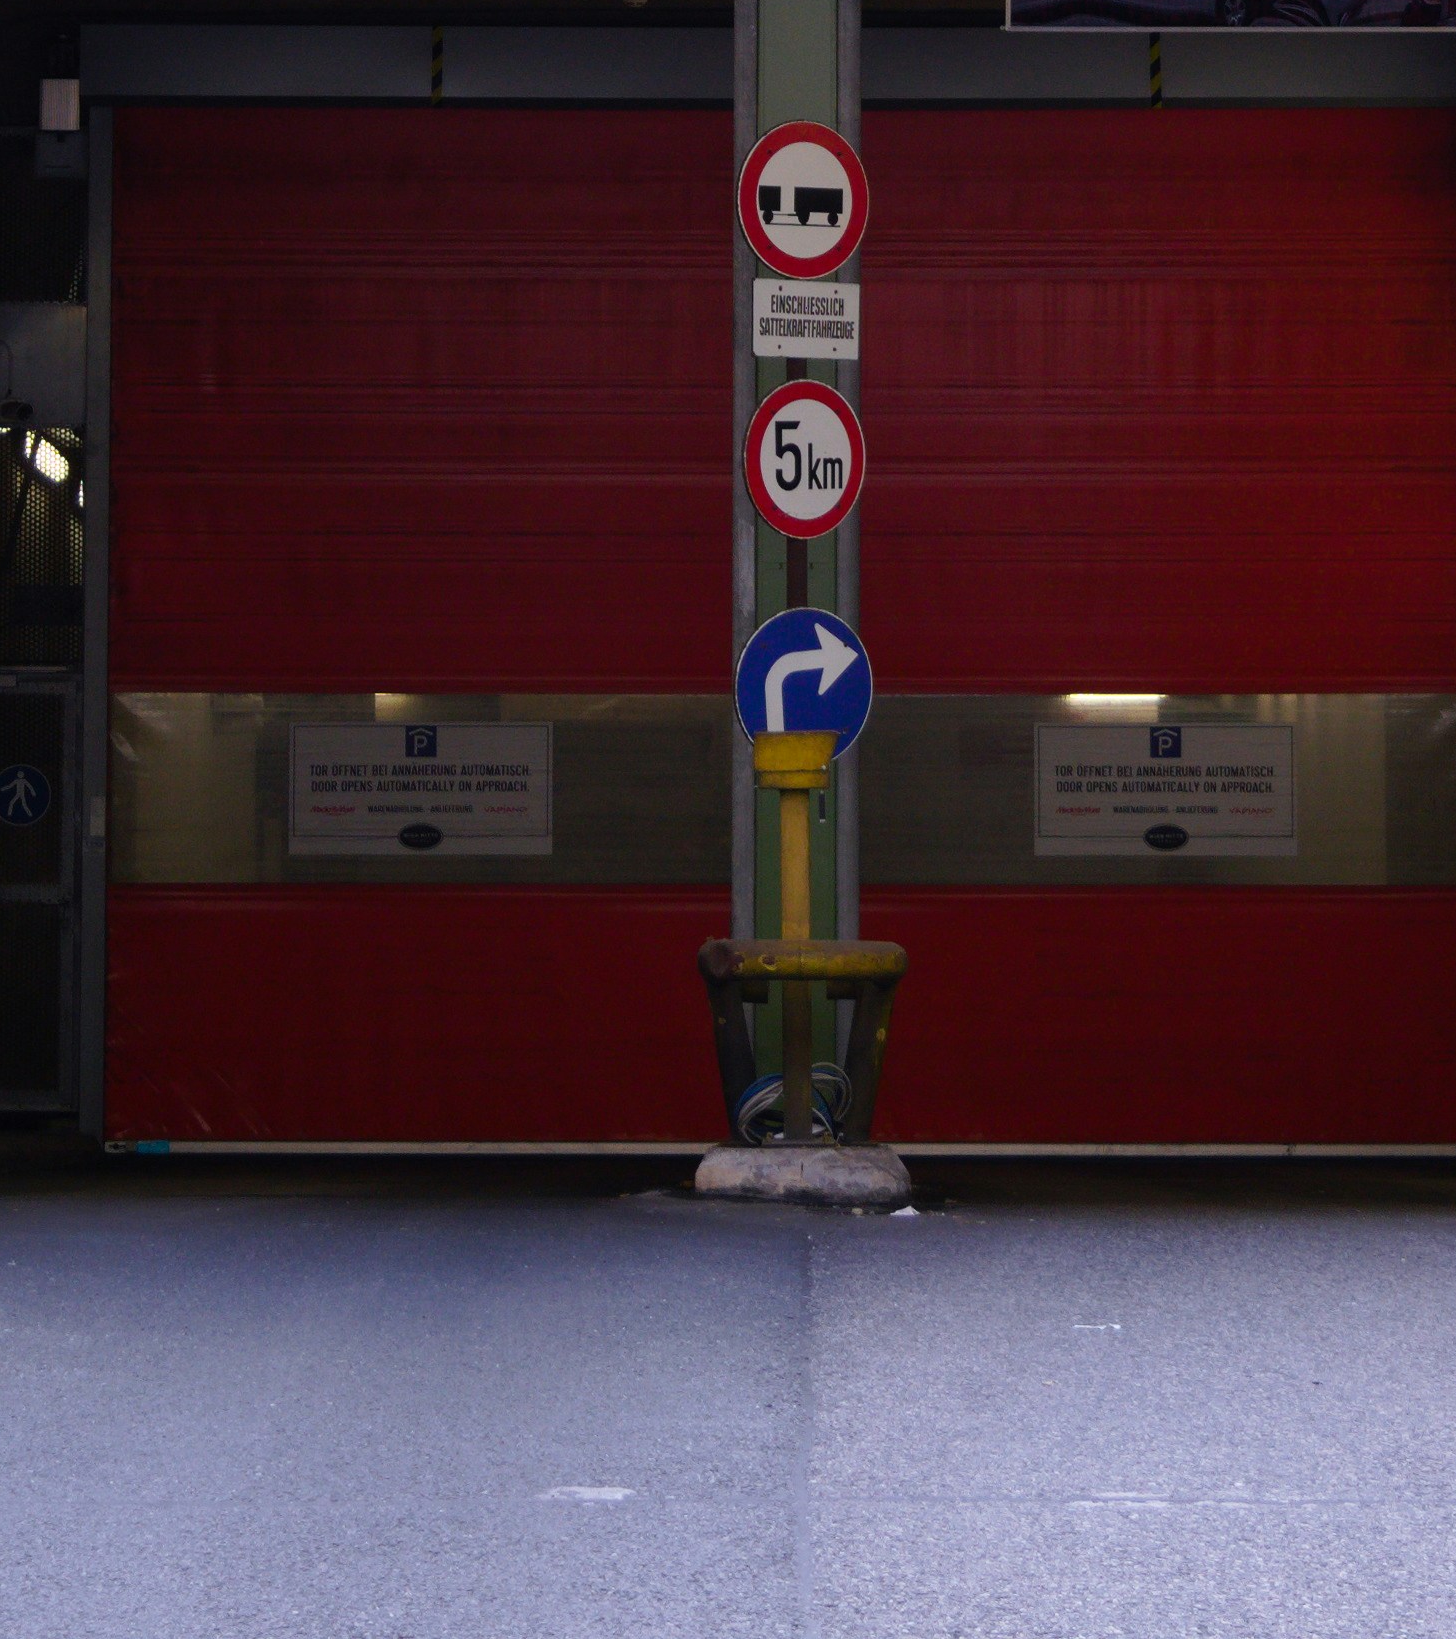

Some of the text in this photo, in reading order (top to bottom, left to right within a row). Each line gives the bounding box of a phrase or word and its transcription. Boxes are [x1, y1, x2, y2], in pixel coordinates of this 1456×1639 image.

[770, 293, 845, 317] EINSCHLIESSLICH
[758, 316, 855, 341] SATTELKRAFTFAHRZEUGE
[774, 420, 844, 492] 5 km
